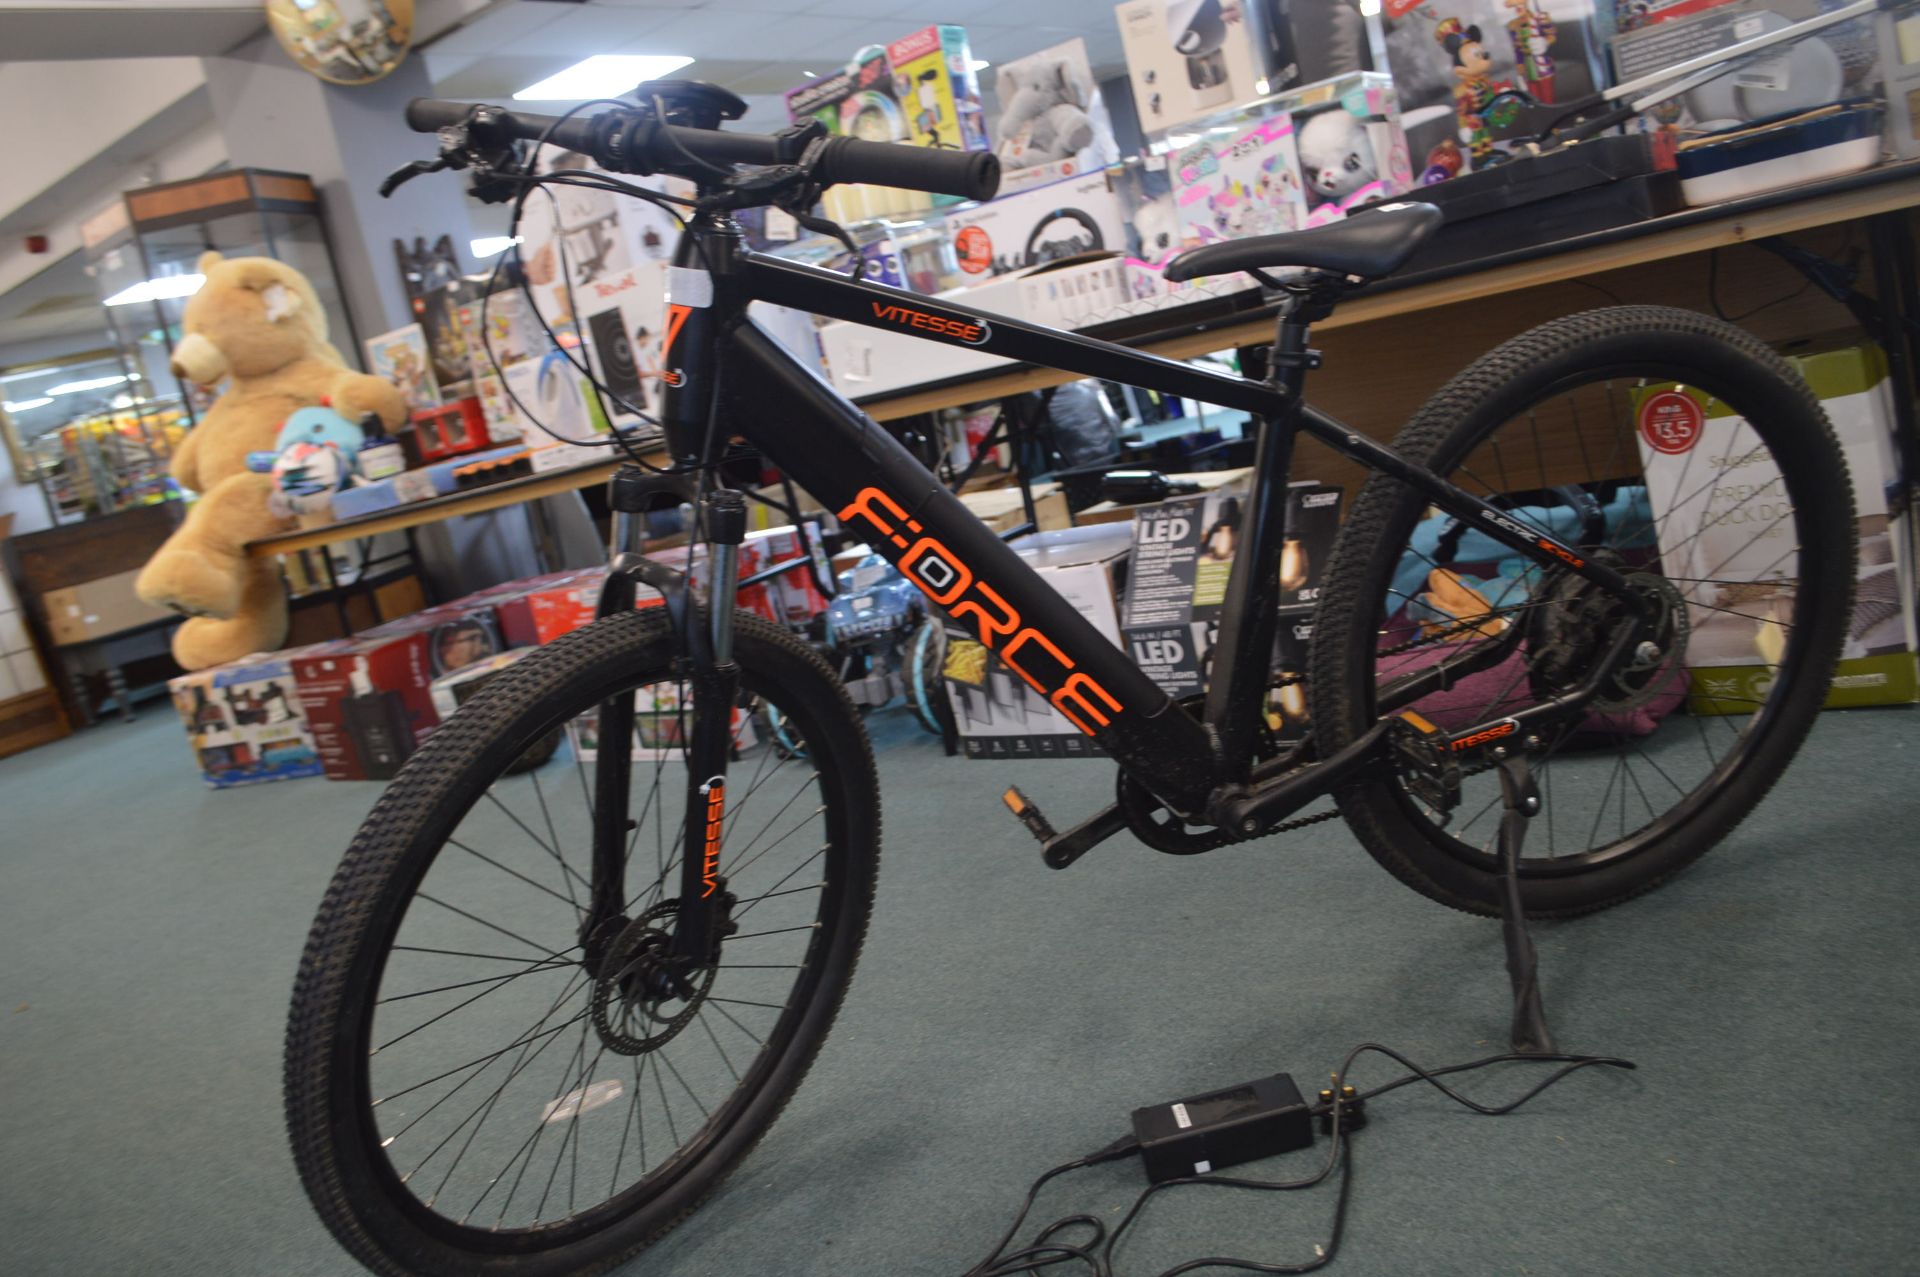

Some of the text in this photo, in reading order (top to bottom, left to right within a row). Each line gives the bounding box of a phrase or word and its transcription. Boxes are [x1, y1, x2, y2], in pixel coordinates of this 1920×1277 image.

[872, 302, 981, 341] VITESSE
[1139, 518, 1191, 544] LED
[838, 487, 1123, 736] FORCE
[1133, 639, 1184, 665] LED
[701, 785, 725, 899] VITESSE
